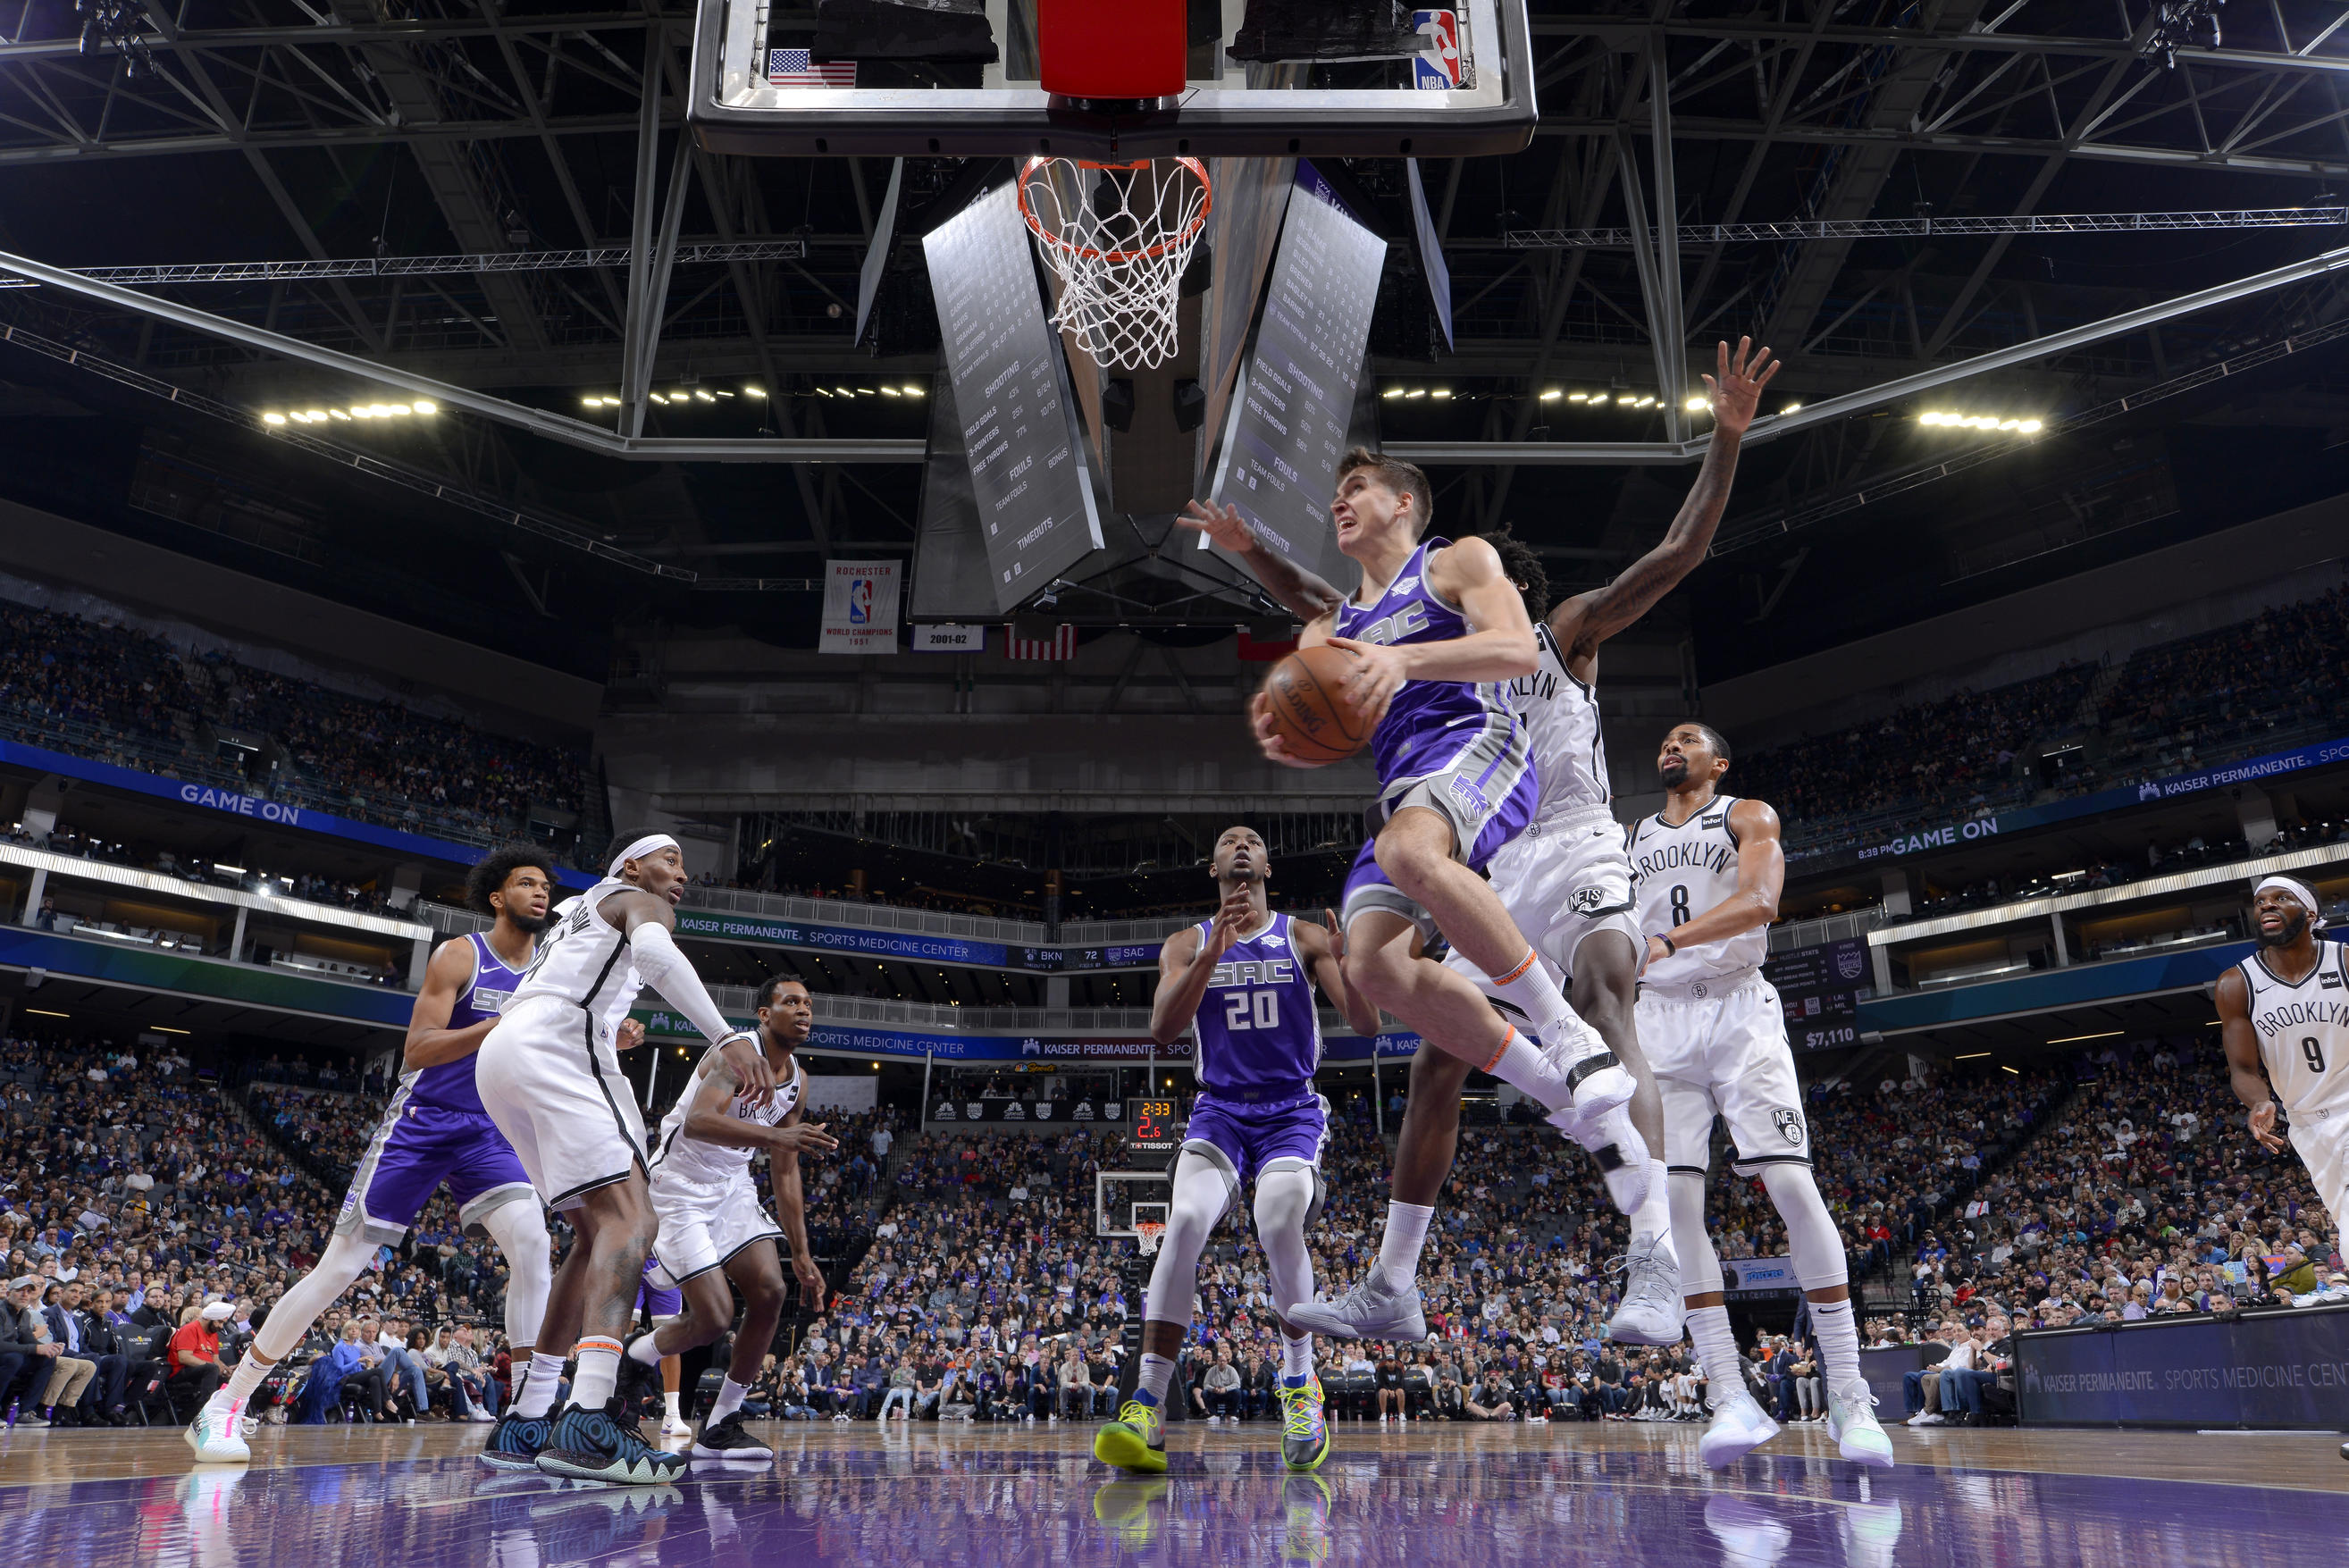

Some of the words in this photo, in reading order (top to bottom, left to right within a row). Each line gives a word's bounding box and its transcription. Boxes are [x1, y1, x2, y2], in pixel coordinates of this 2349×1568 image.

[1422, 76, 1445, 89] NBA
[1290, 264, 1313, 291] BREWER
[1282, 293, 1305, 319] BARNES
[956, 321, 978, 346] GRAHAM
[1276, 312, 1290, 329] TEAM
[1290, 323, 1307, 344] TOTALS
[961, 363, 974, 381] TEAM
[973, 349, 989, 370] TOTALS
[985, 360, 1020, 398] SHOOTING
[1255, 357, 1273, 378] FIELD
[1272, 373, 1292, 394] GOALS
[1251, 377, 1286, 411] 3-POINTERS
[1288, 362, 1324, 400] SHOOTING
[965, 423, 980, 440] FIELD
[980, 406, 997, 426] GOALS
[1247, 397, 1263, 416] FREE
[1263, 408, 1288, 436] THROWS
[969, 425, 1000, 457] 3-POINTERS
[973, 459, 986, 476] FREE
[986, 440, 1009, 464] THROWS
[1009, 456, 1033, 482] FOULS
[1048, 447, 1069, 469] BONUS
[1273, 457, 1299, 483] FOULS
[1250, 458, 1268, 479] TEAM
[1266, 471, 1286, 492] FOULS
[995, 496, 1011, 512] TEAM
[1010, 481, 1028, 502] FOULS
[1305, 503, 1325, 524] BONUS
[1017, 516, 1053, 551] TIMEOUTS
[1253, 517, 1290, 554] TIMEOUTS
[836, 566, 892, 576] ROCHESTER
[826, 628, 850, 636] WORLD
[852, 628, 893, 636] CHAMPIONS
[1354, 599, 1430, 646] AC
[849, 638, 869, 646] 1951
[930, 634, 968, 644] 2001-02
[2164, 776, 2210, 795] KAISER
[2211, 754, 2307, 785] PERMANENTE
[180, 784, 256, 816] GAME
[262, 802, 299, 826] ON
[1702, 817, 1723, 826] infor
[1892, 826, 1956, 855] GAME
[1962, 817, 1998, 840] ON
[1858, 846, 1878, 859] 8:39
[1880, 843, 1894, 855] PM
[1569, 888, 1602, 910] NETS
[1670, 885, 1690, 928] 8
[681, 917, 719, 933] KAISER
[722, 922, 799, 941] PERMANENTE
[810, 931, 856, 947] SPORTS
[859, 936, 919, 953] MEDICINE
[922, 943, 969, 959] CENTER
[1801, 949, 1820, 957] STATS
[1041, 951, 1062, 961] BKN
[1085, 951, 1097, 960] 72
[1123, 947, 1145, 958] SAC
[1207, 959, 1294, 989] SAC
[2320, 975, 2340, 985] infor
[1224, 990, 1279, 1030] 20
[2256, 1002, 2349, 1038] BROOKLYN
[853, 1035, 914, 1051] MEDICINE
[917, 1039, 965, 1054] CENTER
[1044, 1044, 1080, 1054] KAISER
[1084, 1044, 1156, 1055] PERMANENTE
[1806, 1027, 1854, 1049] $7,110
[1027, 1062, 1056, 1073] Sports
[2302, 1036, 2326, 1073] 9
[1142, 1103, 1170, 1116] 2:33
[1774, 1110, 1803, 1128] NETS
[1137, 1116, 1161, 1138] 2.6
[1142, 1143, 1173, 1151] TISSOT
[2043, 1375, 2076, 1394] KAISER
[2079, 1370, 2155, 1392] PERMANENTE
[2166, 1368, 2219, 1390] SPORTS
[2222, 1364, 2303, 1388] MEDICINE
[2308, 1363, 2349, 1387] CEN
